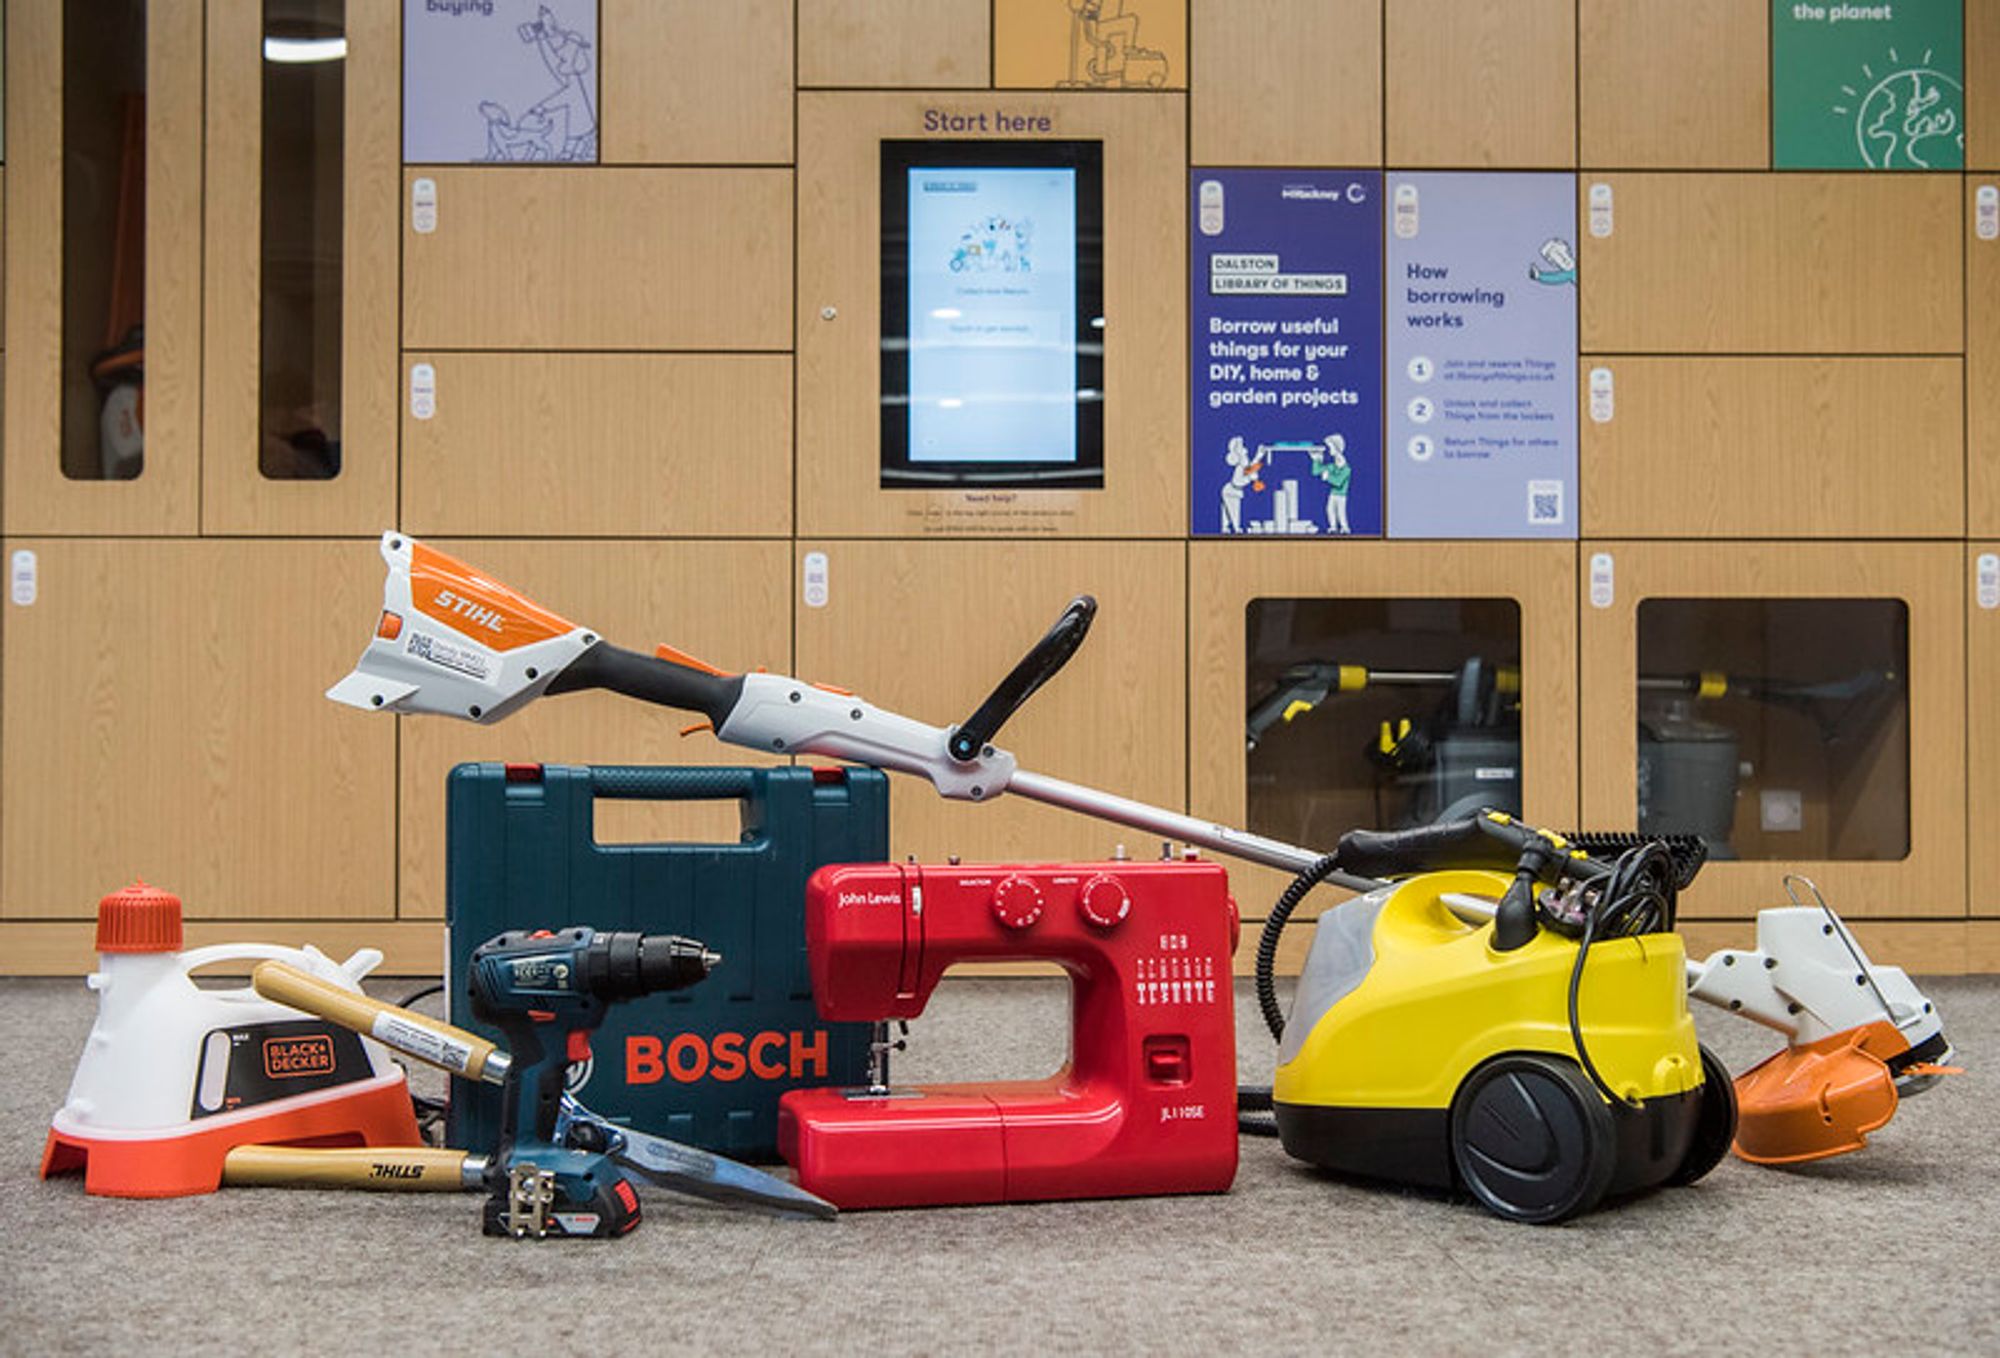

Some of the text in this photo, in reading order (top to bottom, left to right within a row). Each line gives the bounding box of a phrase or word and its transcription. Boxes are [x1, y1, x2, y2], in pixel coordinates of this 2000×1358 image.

[427, 0, 494, 16] buying
[1793, 3, 1892, 24] the planet
[924, 109, 1051, 131] Start here
[1215, 258, 1275, 269] DALSTON
[1407, 263, 1448, 279] How
[1215, 278, 1342, 289] LIBRARY OF THINGS
[1407, 288, 1505, 308] borrowing
[1209, 317, 1339, 334] Borrow useful
[1407, 312, 1463, 327] works
[1209, 340, 1349, 361] things for your
[1209, 364, 1320, 383] DIY, home &
[1416, 363, 1425, 376] 1
[1209, 387, 1359, 408] garden projects
[1416, 402, 1426, 417] 2
[1416, 441, 1427, 455] 3
[434, 590, 506, 632] STIHL
[838, 891, 901, 909] John Lewis
[272, 1055, 329, 1071] DECKER
[626, 1030, 829, 1085] BOSCH
[371, 1164, 425, 1179] STIHL
